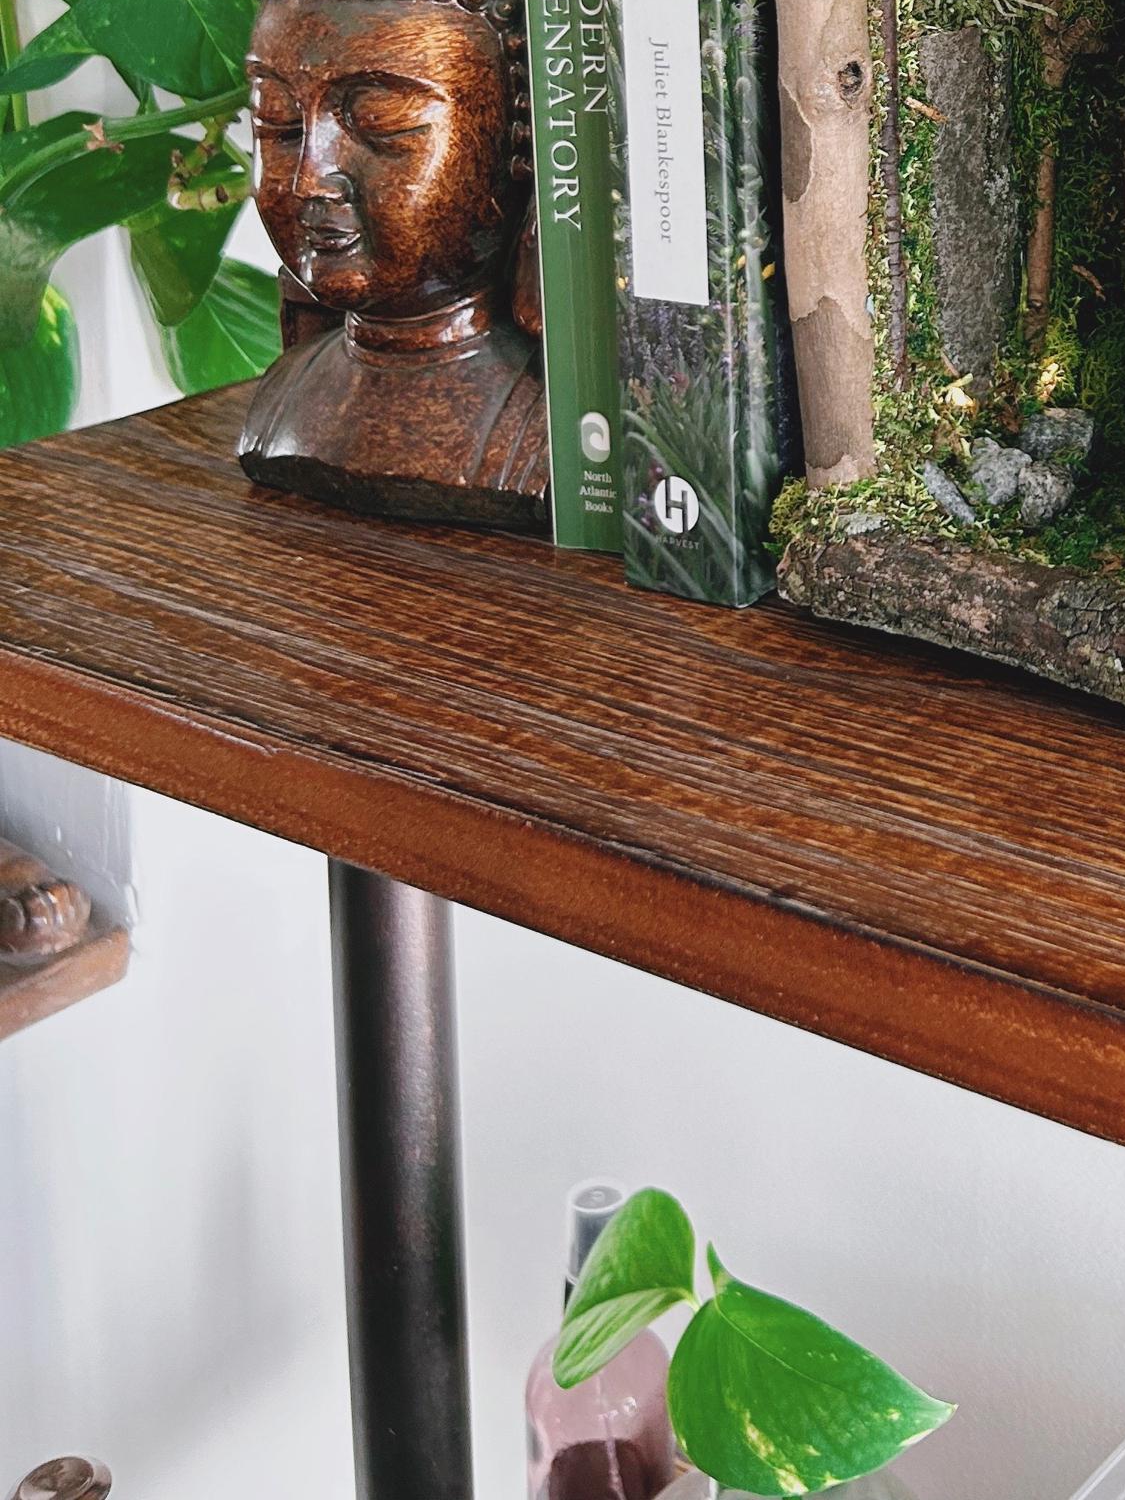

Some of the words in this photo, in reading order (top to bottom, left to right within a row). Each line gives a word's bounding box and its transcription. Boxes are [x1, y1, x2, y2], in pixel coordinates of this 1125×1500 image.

[649, 37, 670, 98] Juliet
[655, 107, 674, 243] Blankespoor
[584, 470, 612, 484] North
[579, 485, 617, 499] Atlantic
[585, 501, 614, 514] Books
[656, 535, 700, 550] HARVEST
